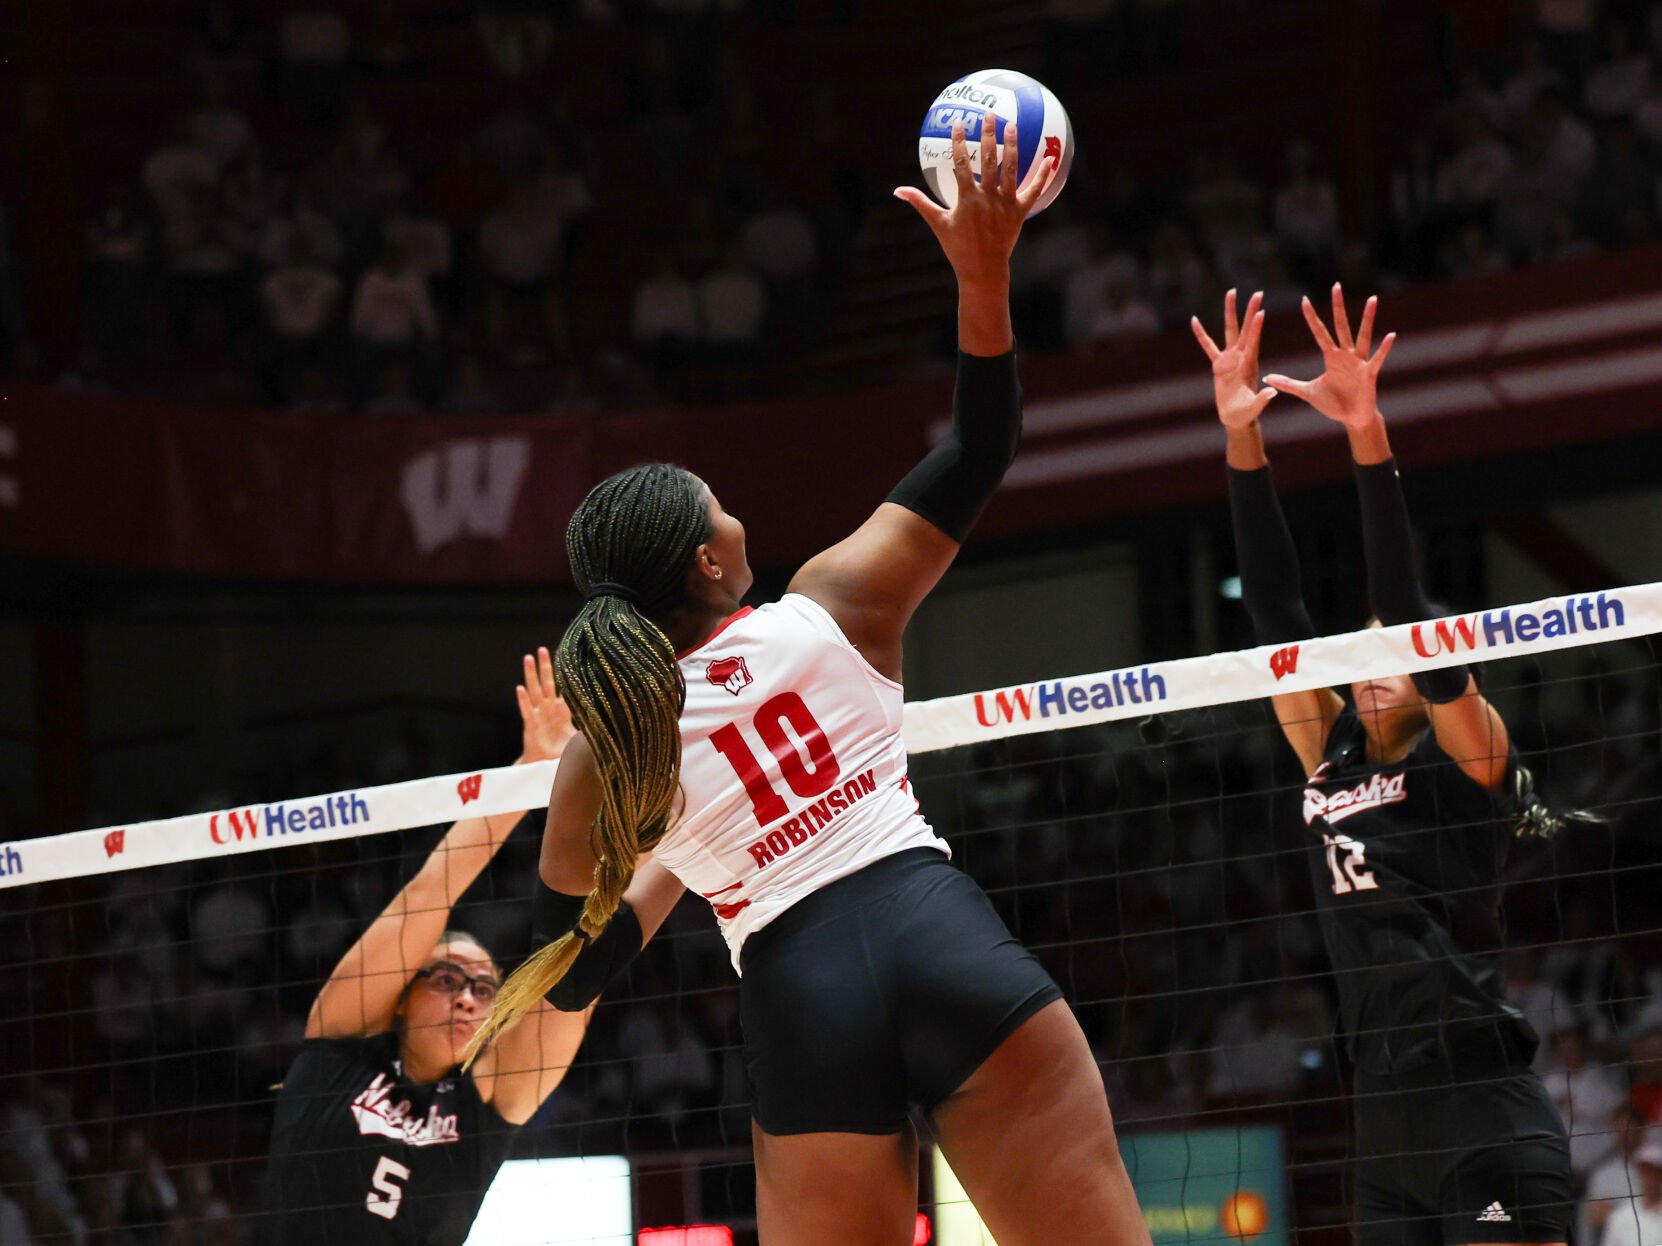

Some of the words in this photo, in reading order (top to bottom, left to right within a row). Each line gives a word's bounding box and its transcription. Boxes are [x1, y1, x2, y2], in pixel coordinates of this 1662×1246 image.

[926, 108, 979, 136] NCAA
[402, 437, 532, 557] W
[1269, 645, 1300, 682] W
[456, 773, 483, 807] W
[708, 691, 841, 828] 10
[103, 830, 125, 859] W
[746, 769, 878, 869] ROBINSON
[1322, 833, 1379, 895] 12
[365, 1155, 412, 1220] 5
